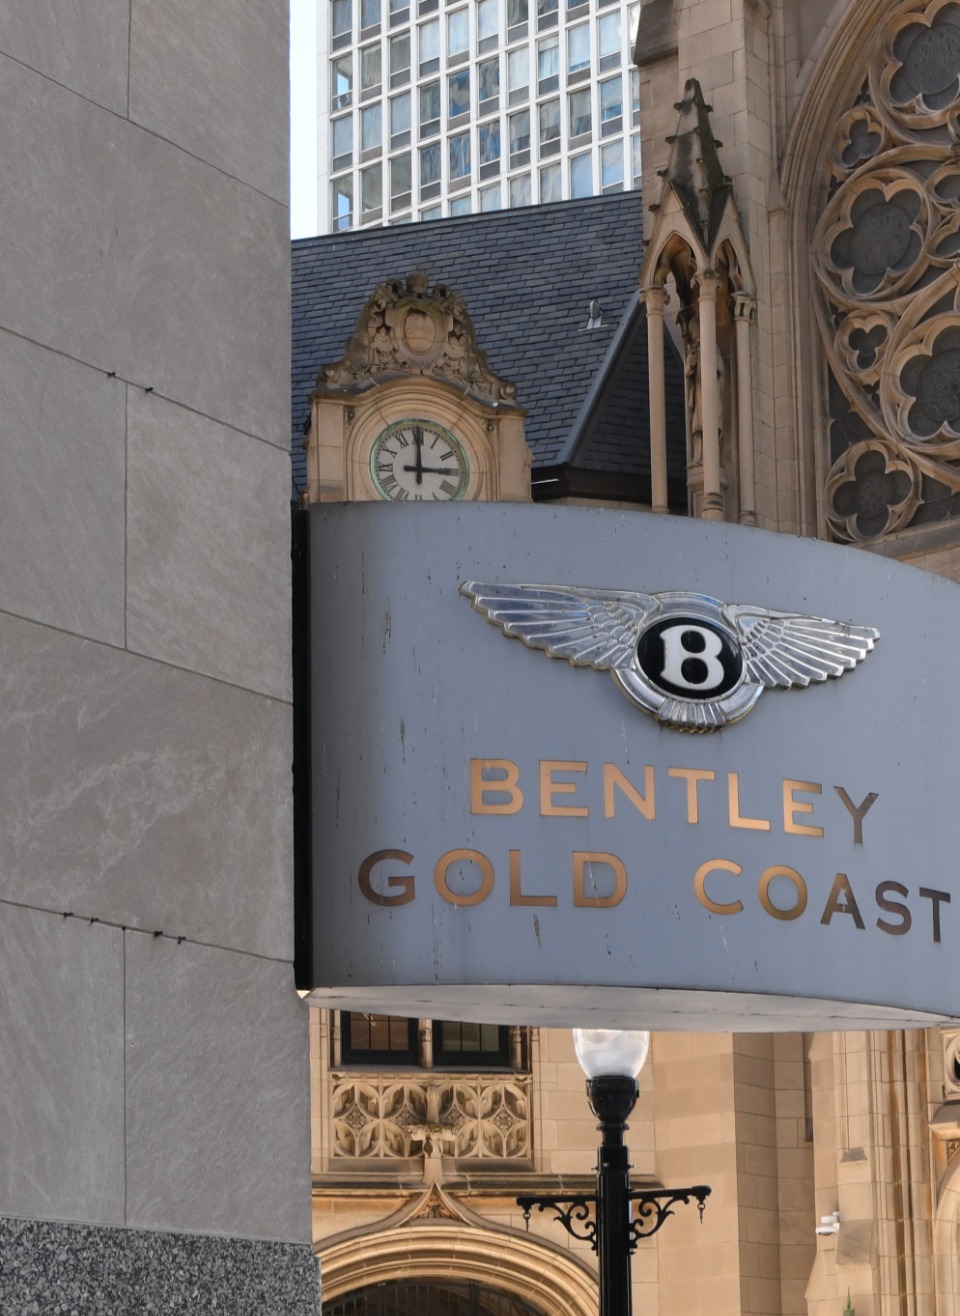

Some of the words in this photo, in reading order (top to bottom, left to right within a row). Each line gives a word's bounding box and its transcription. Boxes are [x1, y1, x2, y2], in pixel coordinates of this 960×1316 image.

[660, 624, 725, 690] B
[469, 757, 879, 845] BENTLEY
[357, 848, 628, 909] GOLD
[693, 858, 952, 944] COAST
